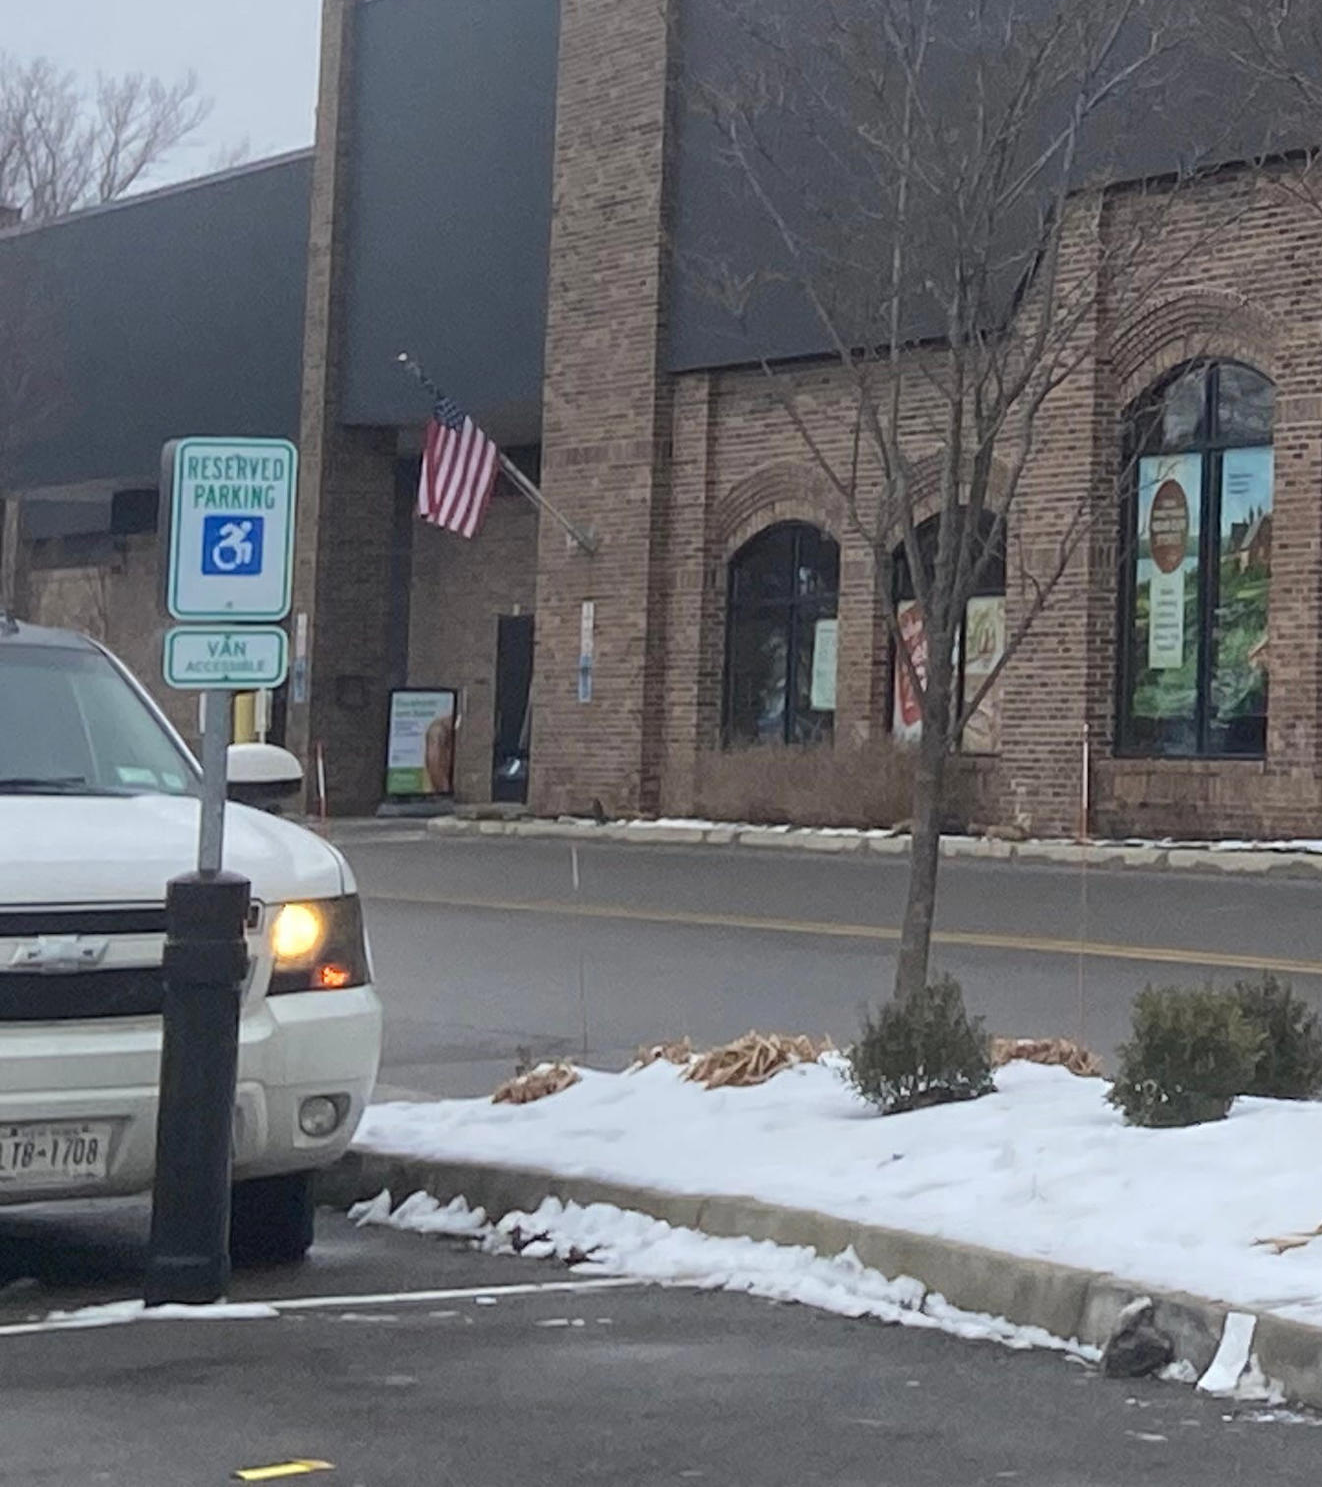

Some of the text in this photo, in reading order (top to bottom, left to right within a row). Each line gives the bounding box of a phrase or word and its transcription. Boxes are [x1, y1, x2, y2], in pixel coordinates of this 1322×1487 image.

[188, 455, 284, 481] RESERVED
[194, 484, 275, 510] PARKING
[207, 640, 247, 658] VAN
